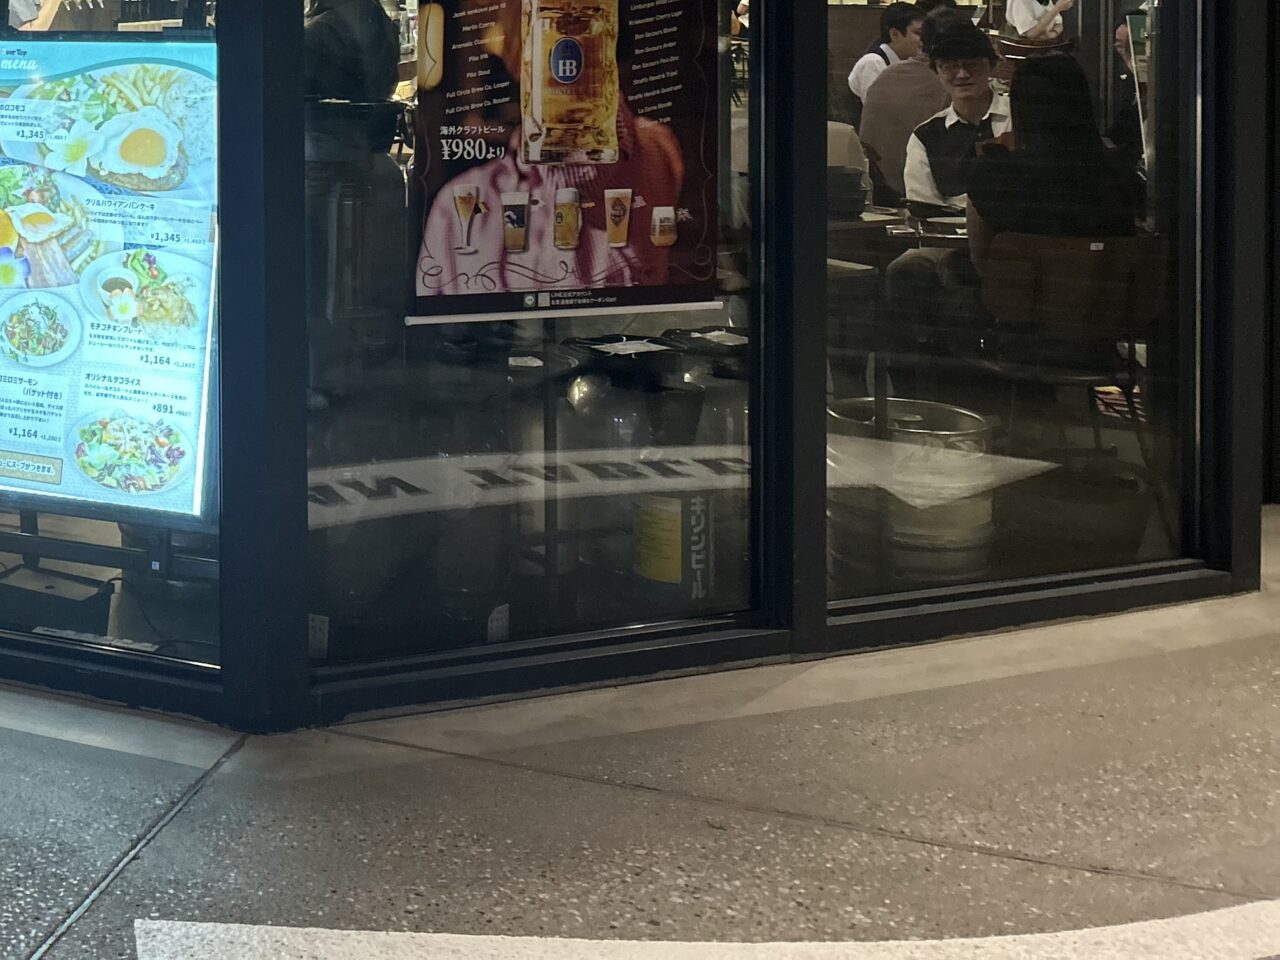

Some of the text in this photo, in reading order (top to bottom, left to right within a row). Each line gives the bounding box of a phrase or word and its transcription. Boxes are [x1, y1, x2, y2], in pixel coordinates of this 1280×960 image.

[0, 56, 38, 70] menu
[558, 59, 578, 77] HB
[16, 131, 44, 142] ¥1,345
[440, 125, 505, 136] 海外クラフトビール
[440, 138, 505, 161] ¥980より
[150, 232, 181, 243] ¥1,345
[140, 354, 170, 366] ¥1,164
[152, 403, 174, 415] ¥891
[9, 427, 38, 439] ¥1,164
